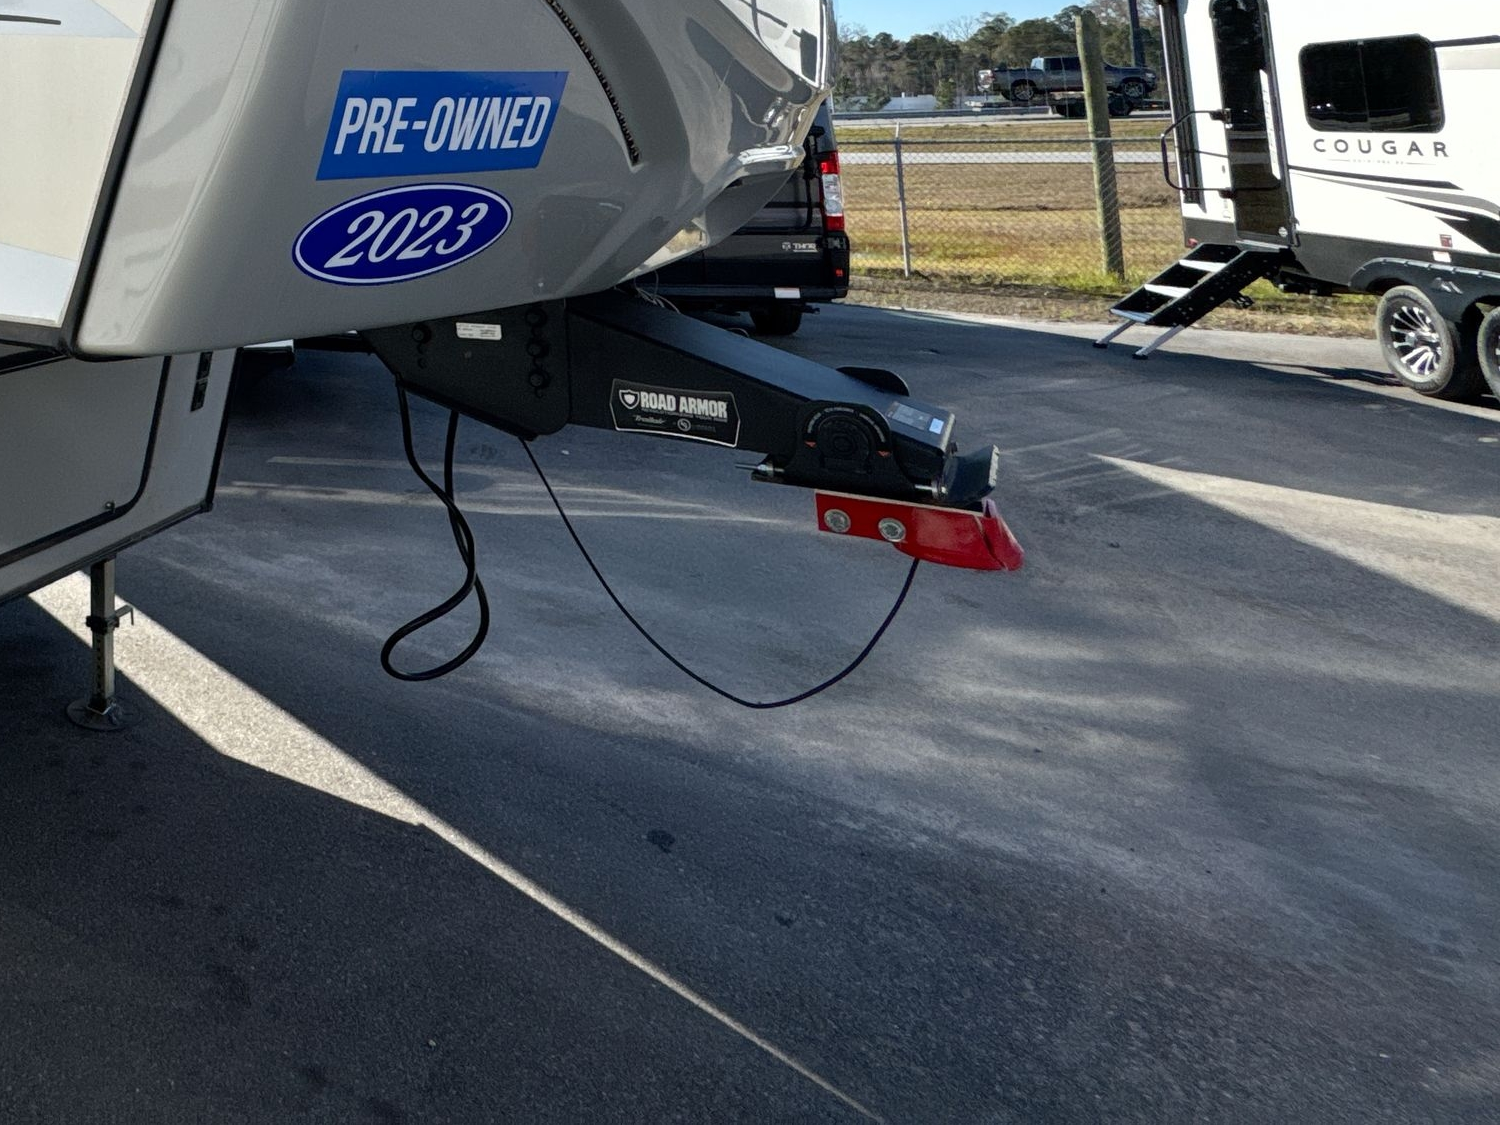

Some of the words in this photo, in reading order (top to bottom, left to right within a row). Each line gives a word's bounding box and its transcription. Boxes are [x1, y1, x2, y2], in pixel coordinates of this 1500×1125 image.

[333, 96, 552, 155] PRE-OWNED
[1313, 138, 1449, 158] COUGAR
[323, 202, 489, 268] 2023
[640, 391, 676, 412] ROAD
[679, 395, 728, 419] ARMOR
